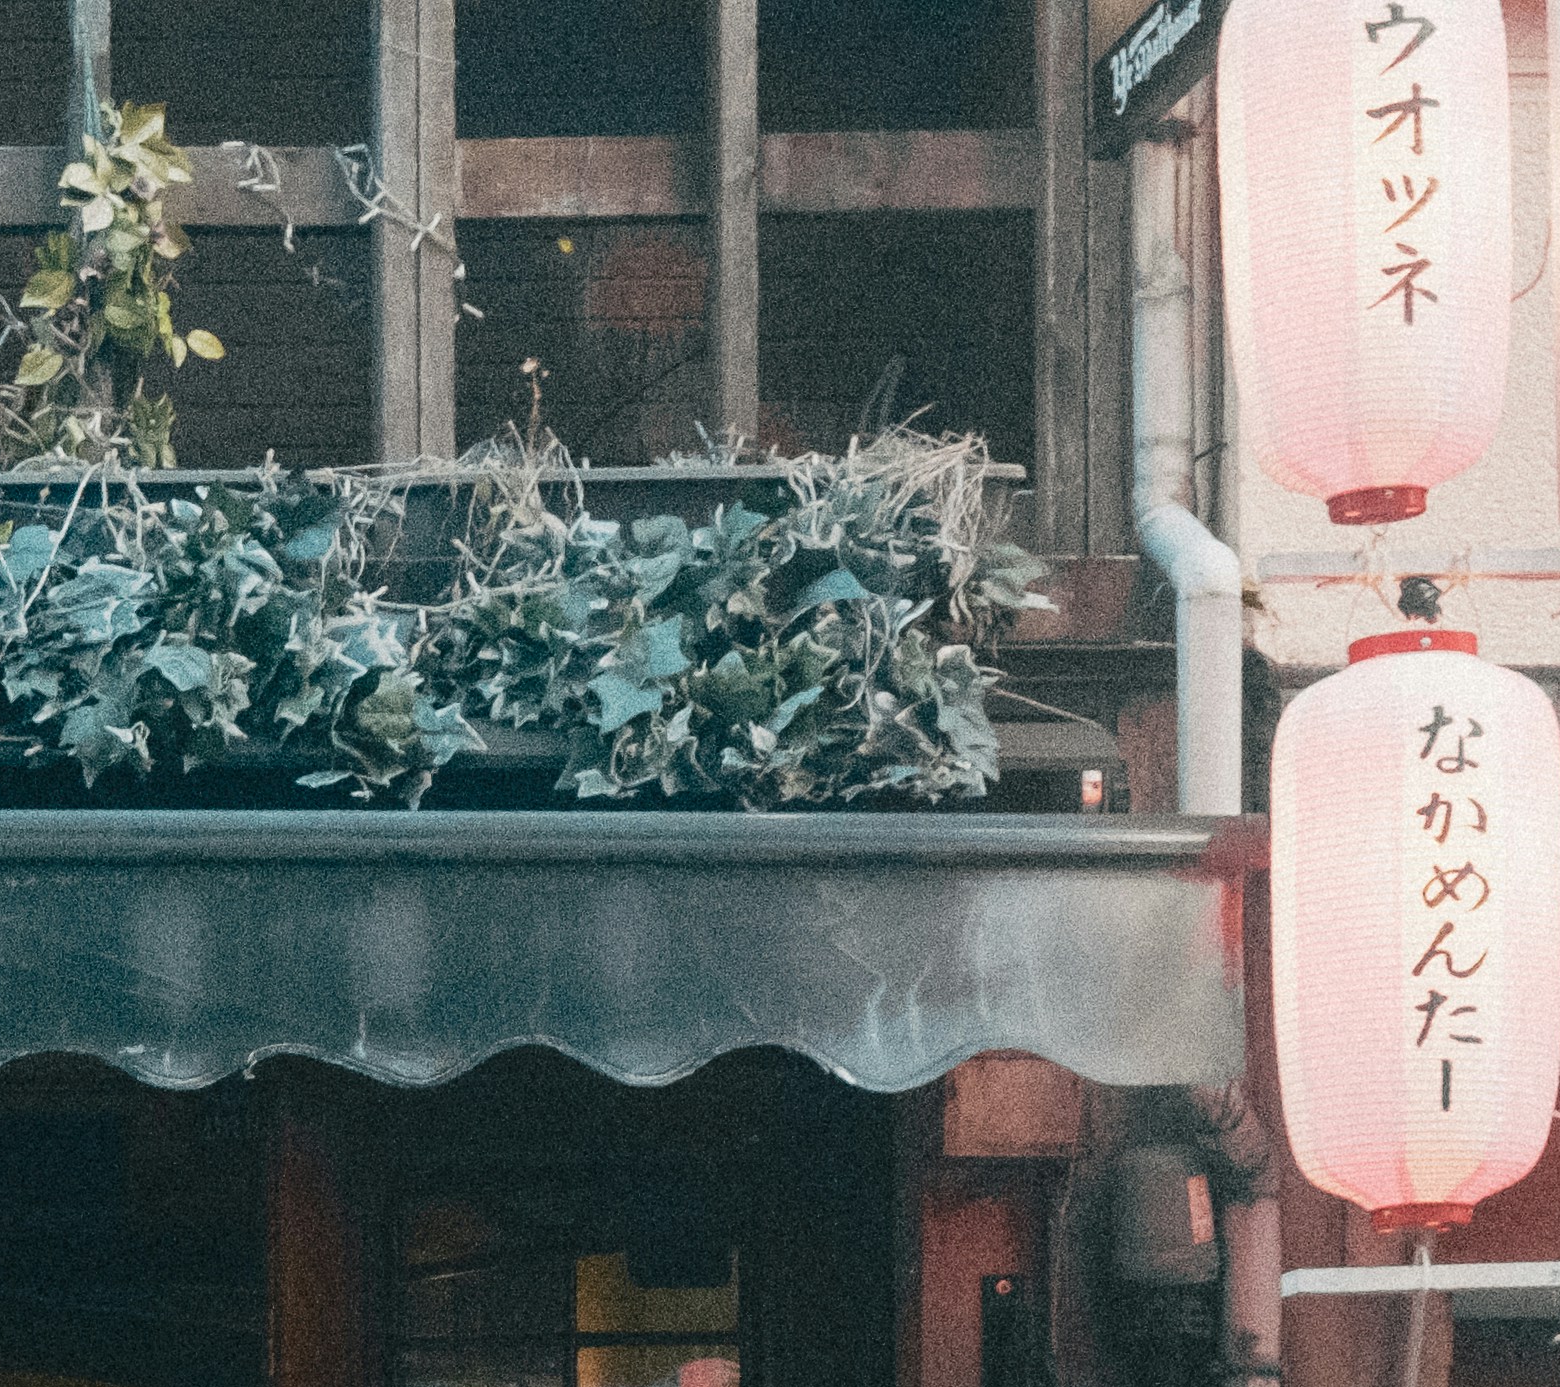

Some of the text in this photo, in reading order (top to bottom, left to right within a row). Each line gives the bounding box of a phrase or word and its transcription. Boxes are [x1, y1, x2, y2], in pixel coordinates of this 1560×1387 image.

[1411, 704, 1492, 1114] なかめんたー
